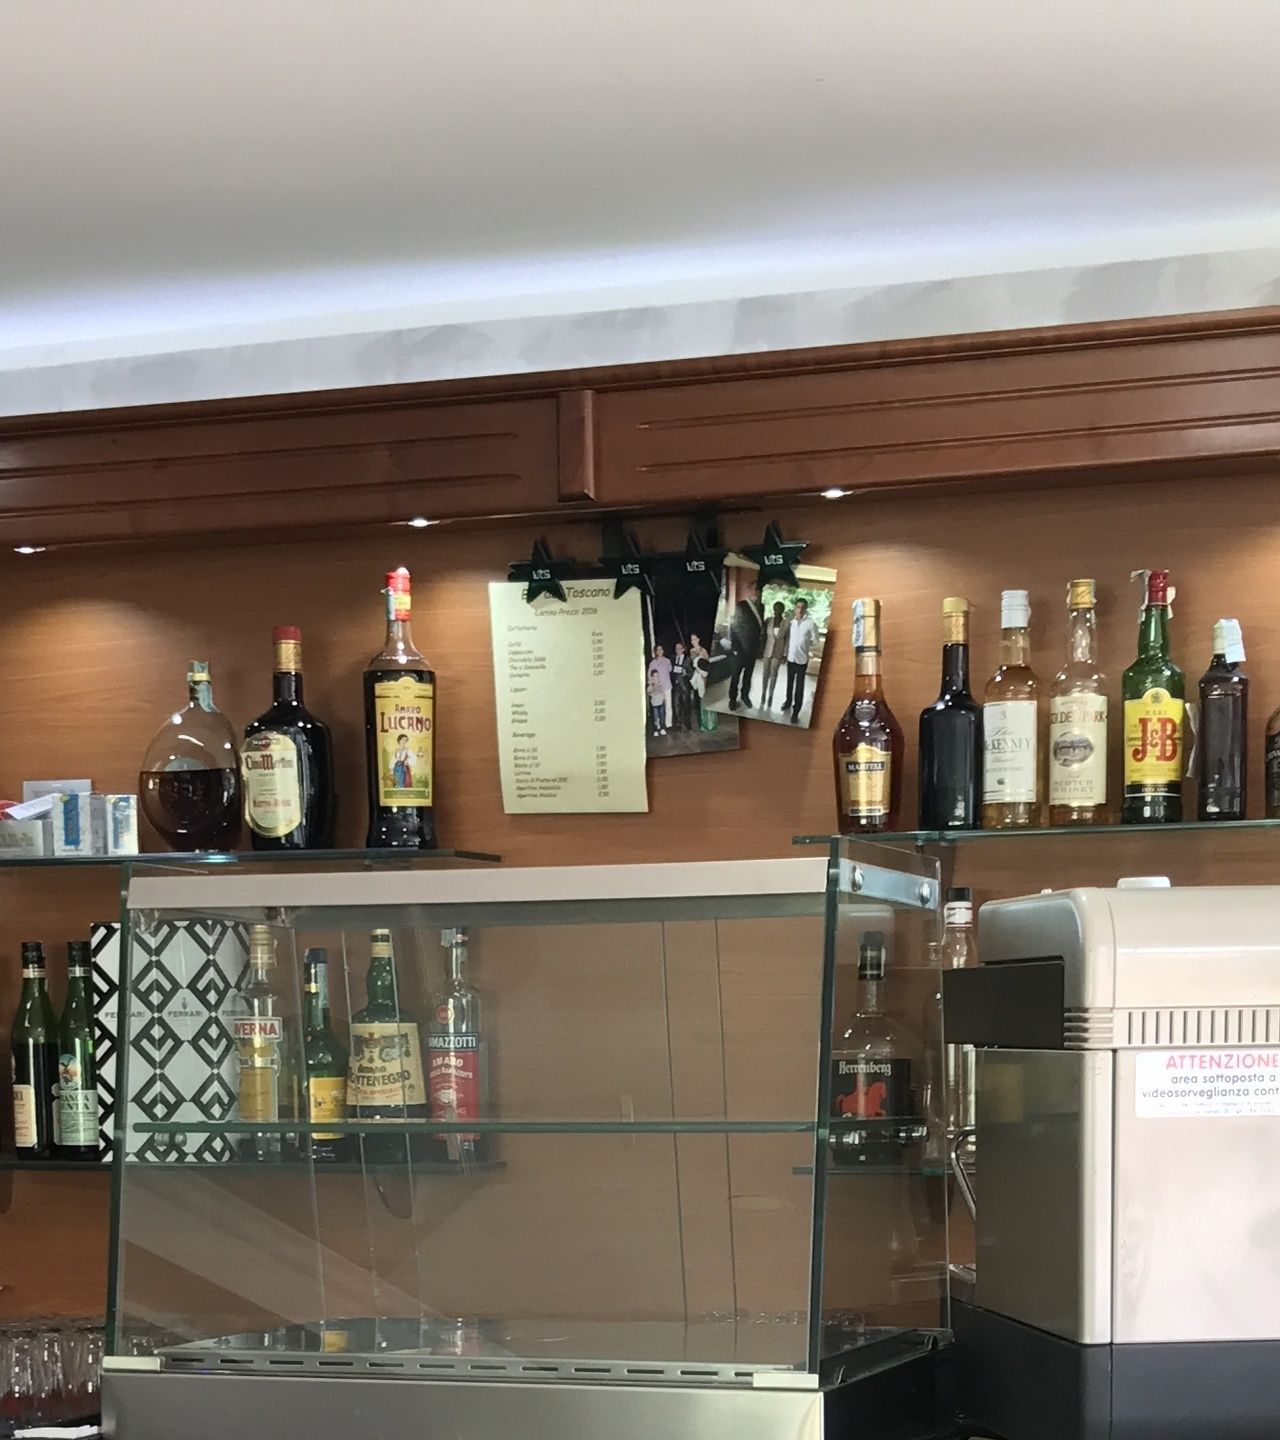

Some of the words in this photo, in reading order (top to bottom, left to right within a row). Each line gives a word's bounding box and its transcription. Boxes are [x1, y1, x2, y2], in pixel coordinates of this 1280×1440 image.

[566, 586, 610, 599] Toscano
[380, 712, 432, 733] LUCANO
[1132, 717, 1178, 762] J&B
[1166, 1053, 1280, 1070] ATTENZIONE
[1171, 1075, 1198, 1084] area
[1202, 1073, 1264, 1086] sottoposta
[1269, 1074, 1276, 1082] a
[1142, 1086, 1250, 1099] videosorveglianza
